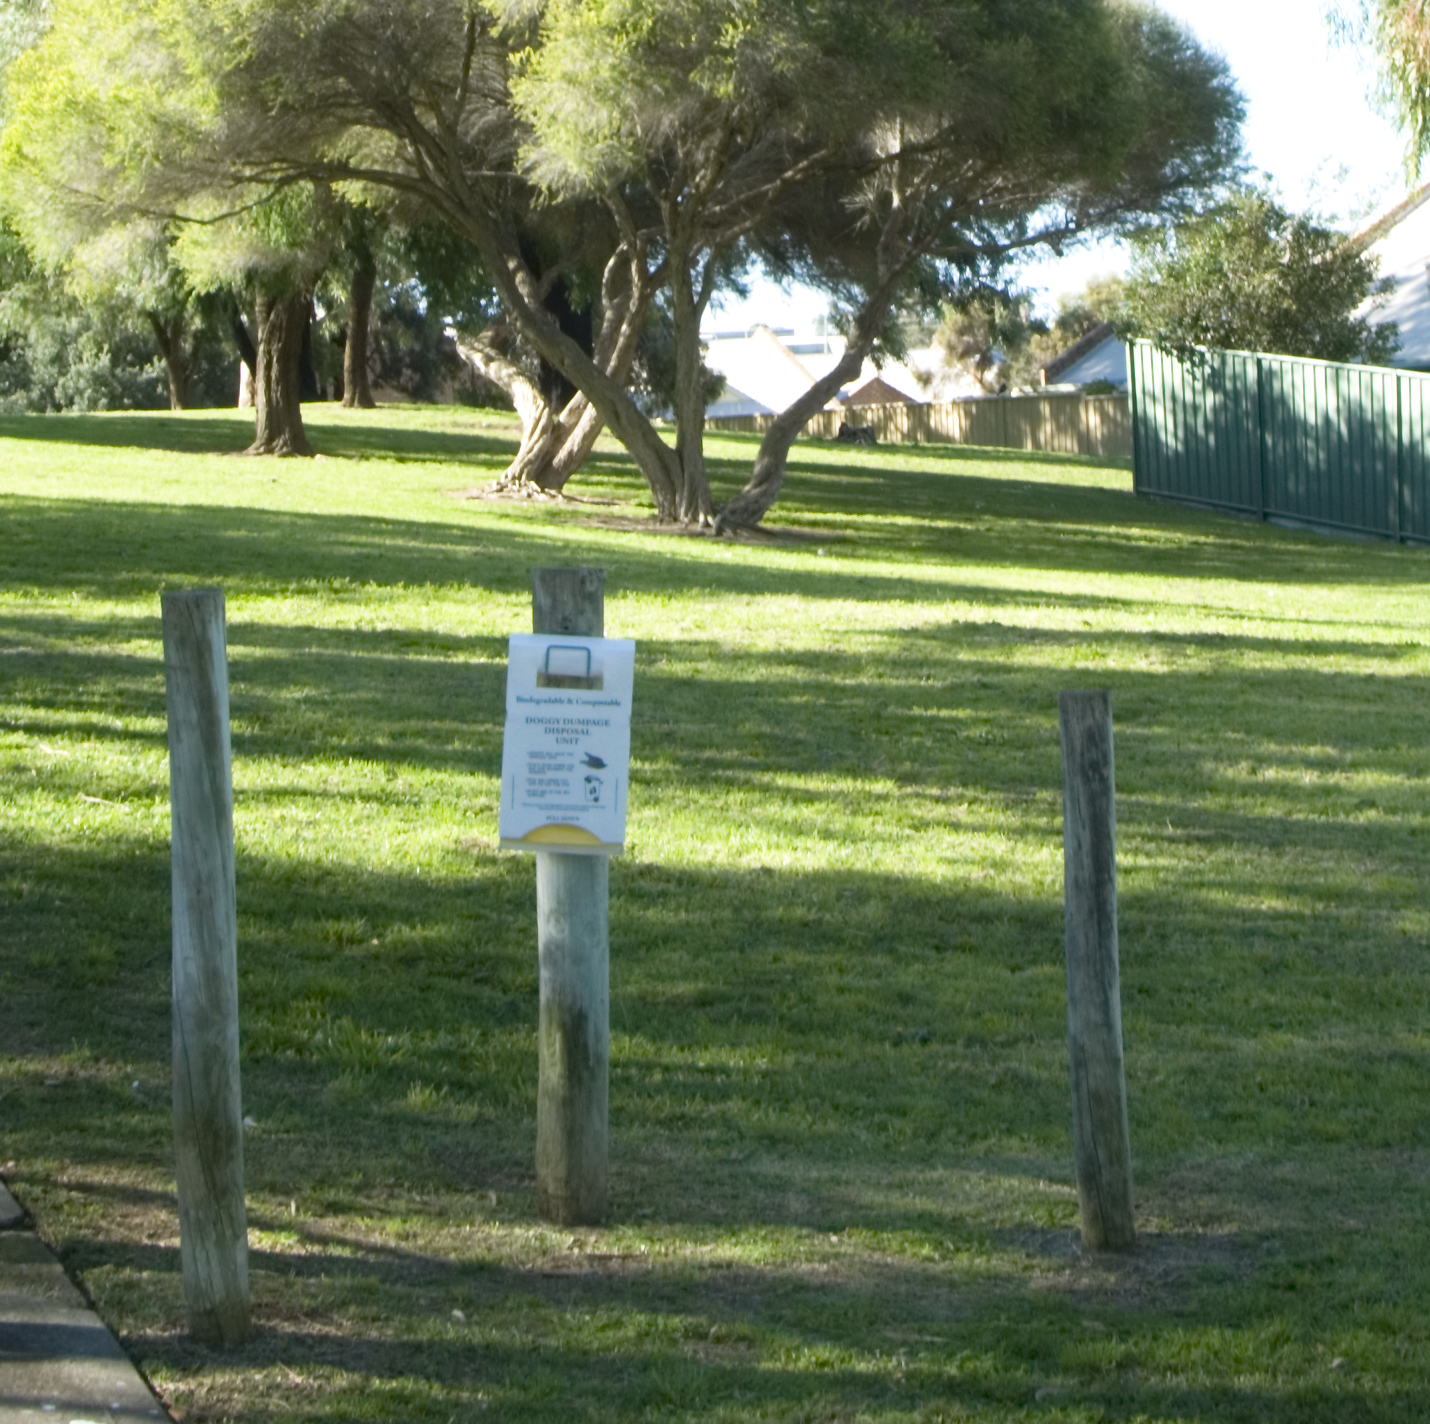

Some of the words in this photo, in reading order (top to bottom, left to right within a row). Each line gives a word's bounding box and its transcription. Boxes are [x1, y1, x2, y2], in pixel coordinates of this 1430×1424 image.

[525, 716, 560, 725] DOGGY
[562, 718, 611, 727] DUMPAGE
[544, 726, 591, 736] DISPOSAL
[555, 737, 580, 745] UNIT
